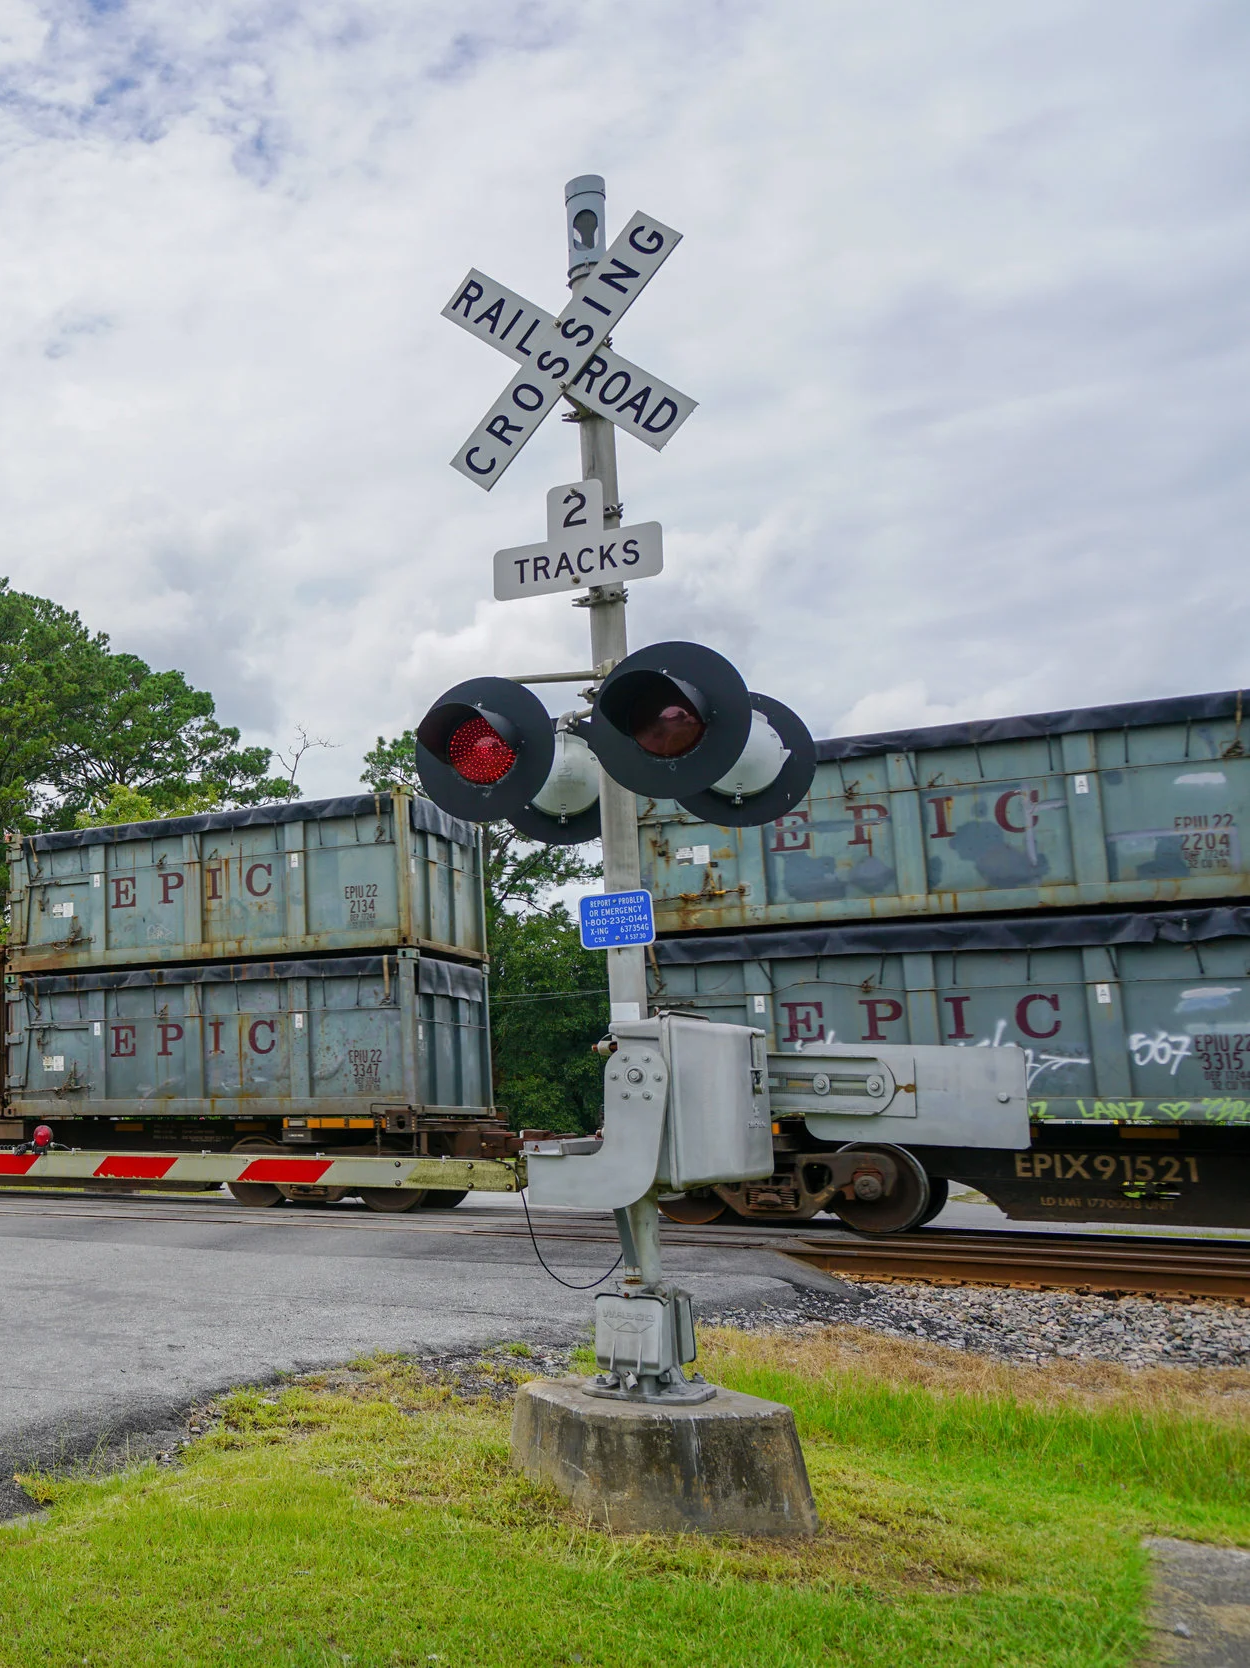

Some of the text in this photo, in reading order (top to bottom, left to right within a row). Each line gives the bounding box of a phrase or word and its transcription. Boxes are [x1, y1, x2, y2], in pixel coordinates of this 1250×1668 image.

[451, 279, 678, 434] RAIL ROAD
[465, 225, 664, 475] CROSSING
[562, 492, 587, 528] 2
[514, 539, 640, 584] TRACKS
[770, 789, 1039, 852] EPIC
[1181, 832, 1230, 851] 2204
[111, 863, 272, 909] EPIC
[344, 884, 378, 899] EPIU 22
[350, 899, 375, 913] 2134
[589, 895, 644, 908] REPORT PROBLEM
[589, 905, 642, 917] OR EMERGENCY
[585, 914, 648, 927] 1-800-232-0144
[590, 923, 650, 936] X-ING 637354G
[780, 993, 1062, 1043] EPIC
[110, 1019, 276, 1057] EPIC
[1194, 1035, 1230, 1052] EPIU
[348, 1049, 383, 1064] EPIU 22
[1129, 1031, 1192, 1075] 567
[1201, 1052, 1244, 1070] 3315
[353, 1063, 379, 1077] 3347
[1076, 1100, 1152, 1120] LANZ
[1014, 1153, 1199, 1183] EPIX 91521
